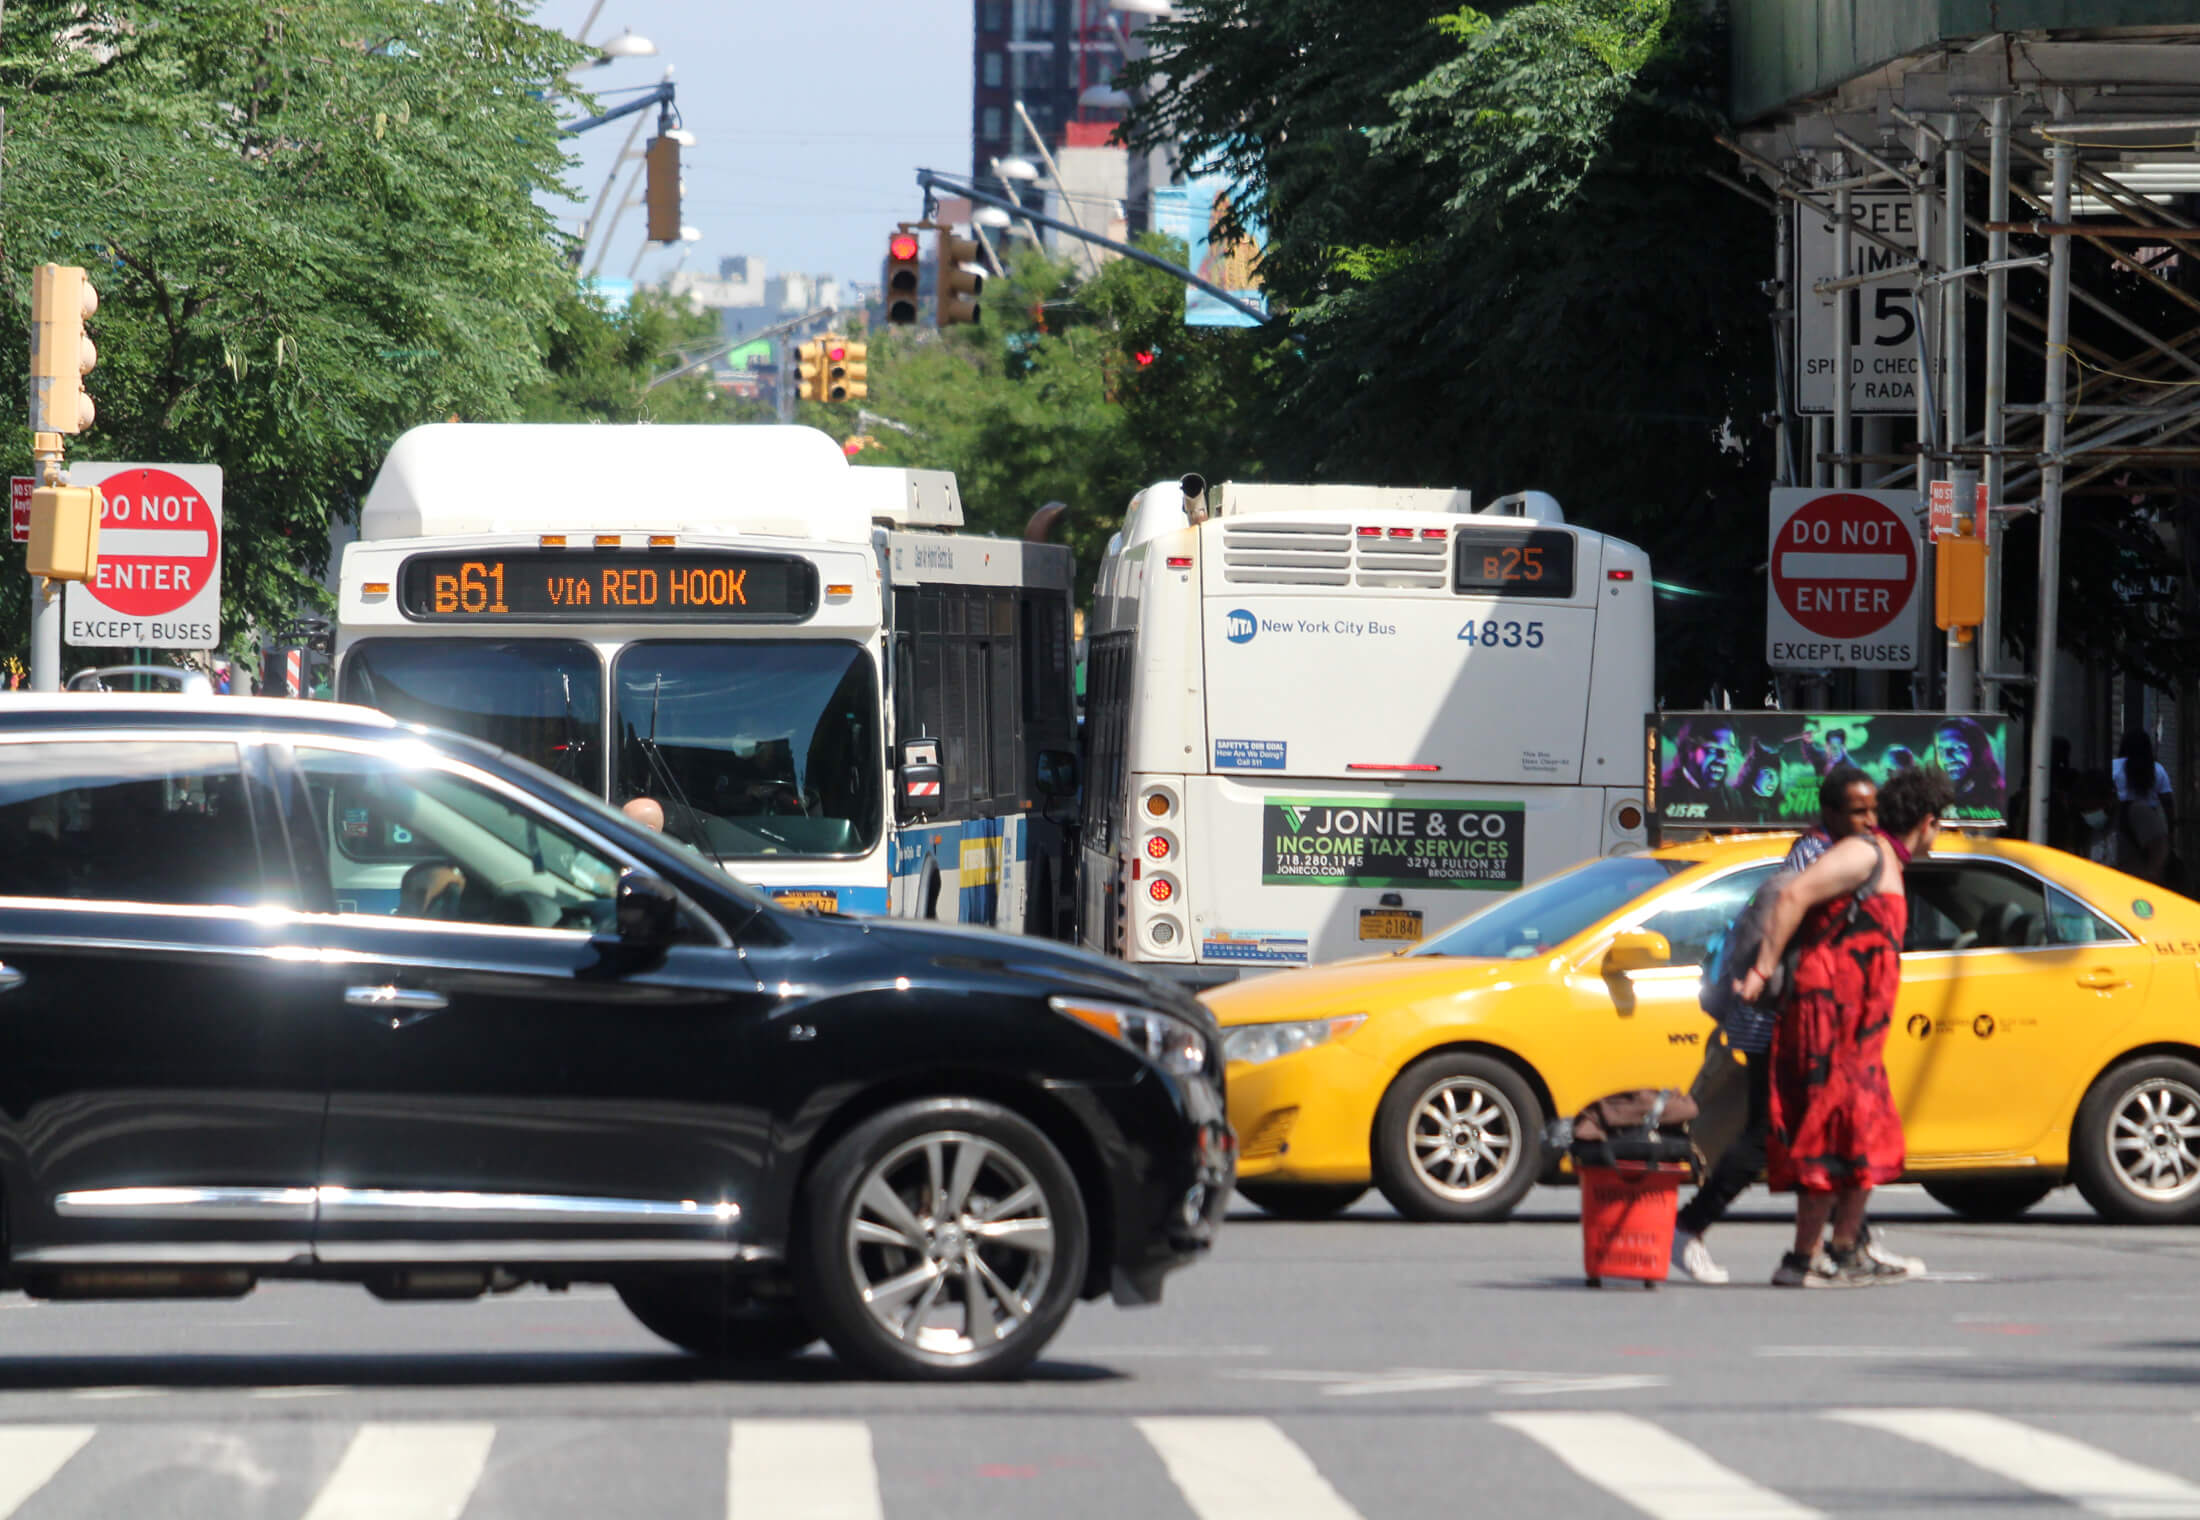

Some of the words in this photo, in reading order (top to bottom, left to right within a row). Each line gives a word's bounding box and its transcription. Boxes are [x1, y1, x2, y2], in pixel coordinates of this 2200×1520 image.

[1823, 203, 1938, 234] SPEE
[1850, 288, 1915, 346] 15
[1807, 358, 1864, 374] SPD
[1866, 383, 1915, 398] RADA
[142, 496, 198, 522] NOT
[1793, 520, 1830, 544] DO
[1842, 521, 1896, 545] NOT
[1483, 547, 1544, 581] B25
[96, 564, 191, 590] ENTER
[435, 562, 509, 613] B61
[547, 578, 591, 605] VIA
[602, 569, 658, 605] RED
[669, 569, 747, 605] HOOK
[1797, 587, 1890, 613] ENTER
[73, 621, 143, 638] EXCEPT
[152, 623, 213, 640] BUSES
[1226, 614, 1254, 639] MTA
[1262, 619, 1293, 633] New
[1298, 620, 1330, 634] York
[1334, 620, 1364, 637] City
[1368, 622, 1396, 636] Bus
[1457, 619, 1544, 648] 4835
[1774, 643, 1841, 660] EXCEPT
[1851, 645, 1911, 662] BUSES
[1315, 809, 1416, 836] JONIE
[1426, 812, 1447, 837] &
[1458, 813, 1506, 838] CO
[1276, 835, 1364, 856] INCOME
[1369, 838, 1408, 856] TAX
[1414, 839, 1509, 858] SERVICES
[1276, 865, 1346, 876] JONIECO.COM
[1277, 855, 1364, 867] 718.280.1145
[1407, 857, 1437, 868] 3296
[1442, 859, 1488, 870] FULTON
[1493, 860, 1507, 870] ST
[1428, 868, 1477, 878] BROOKLYN
